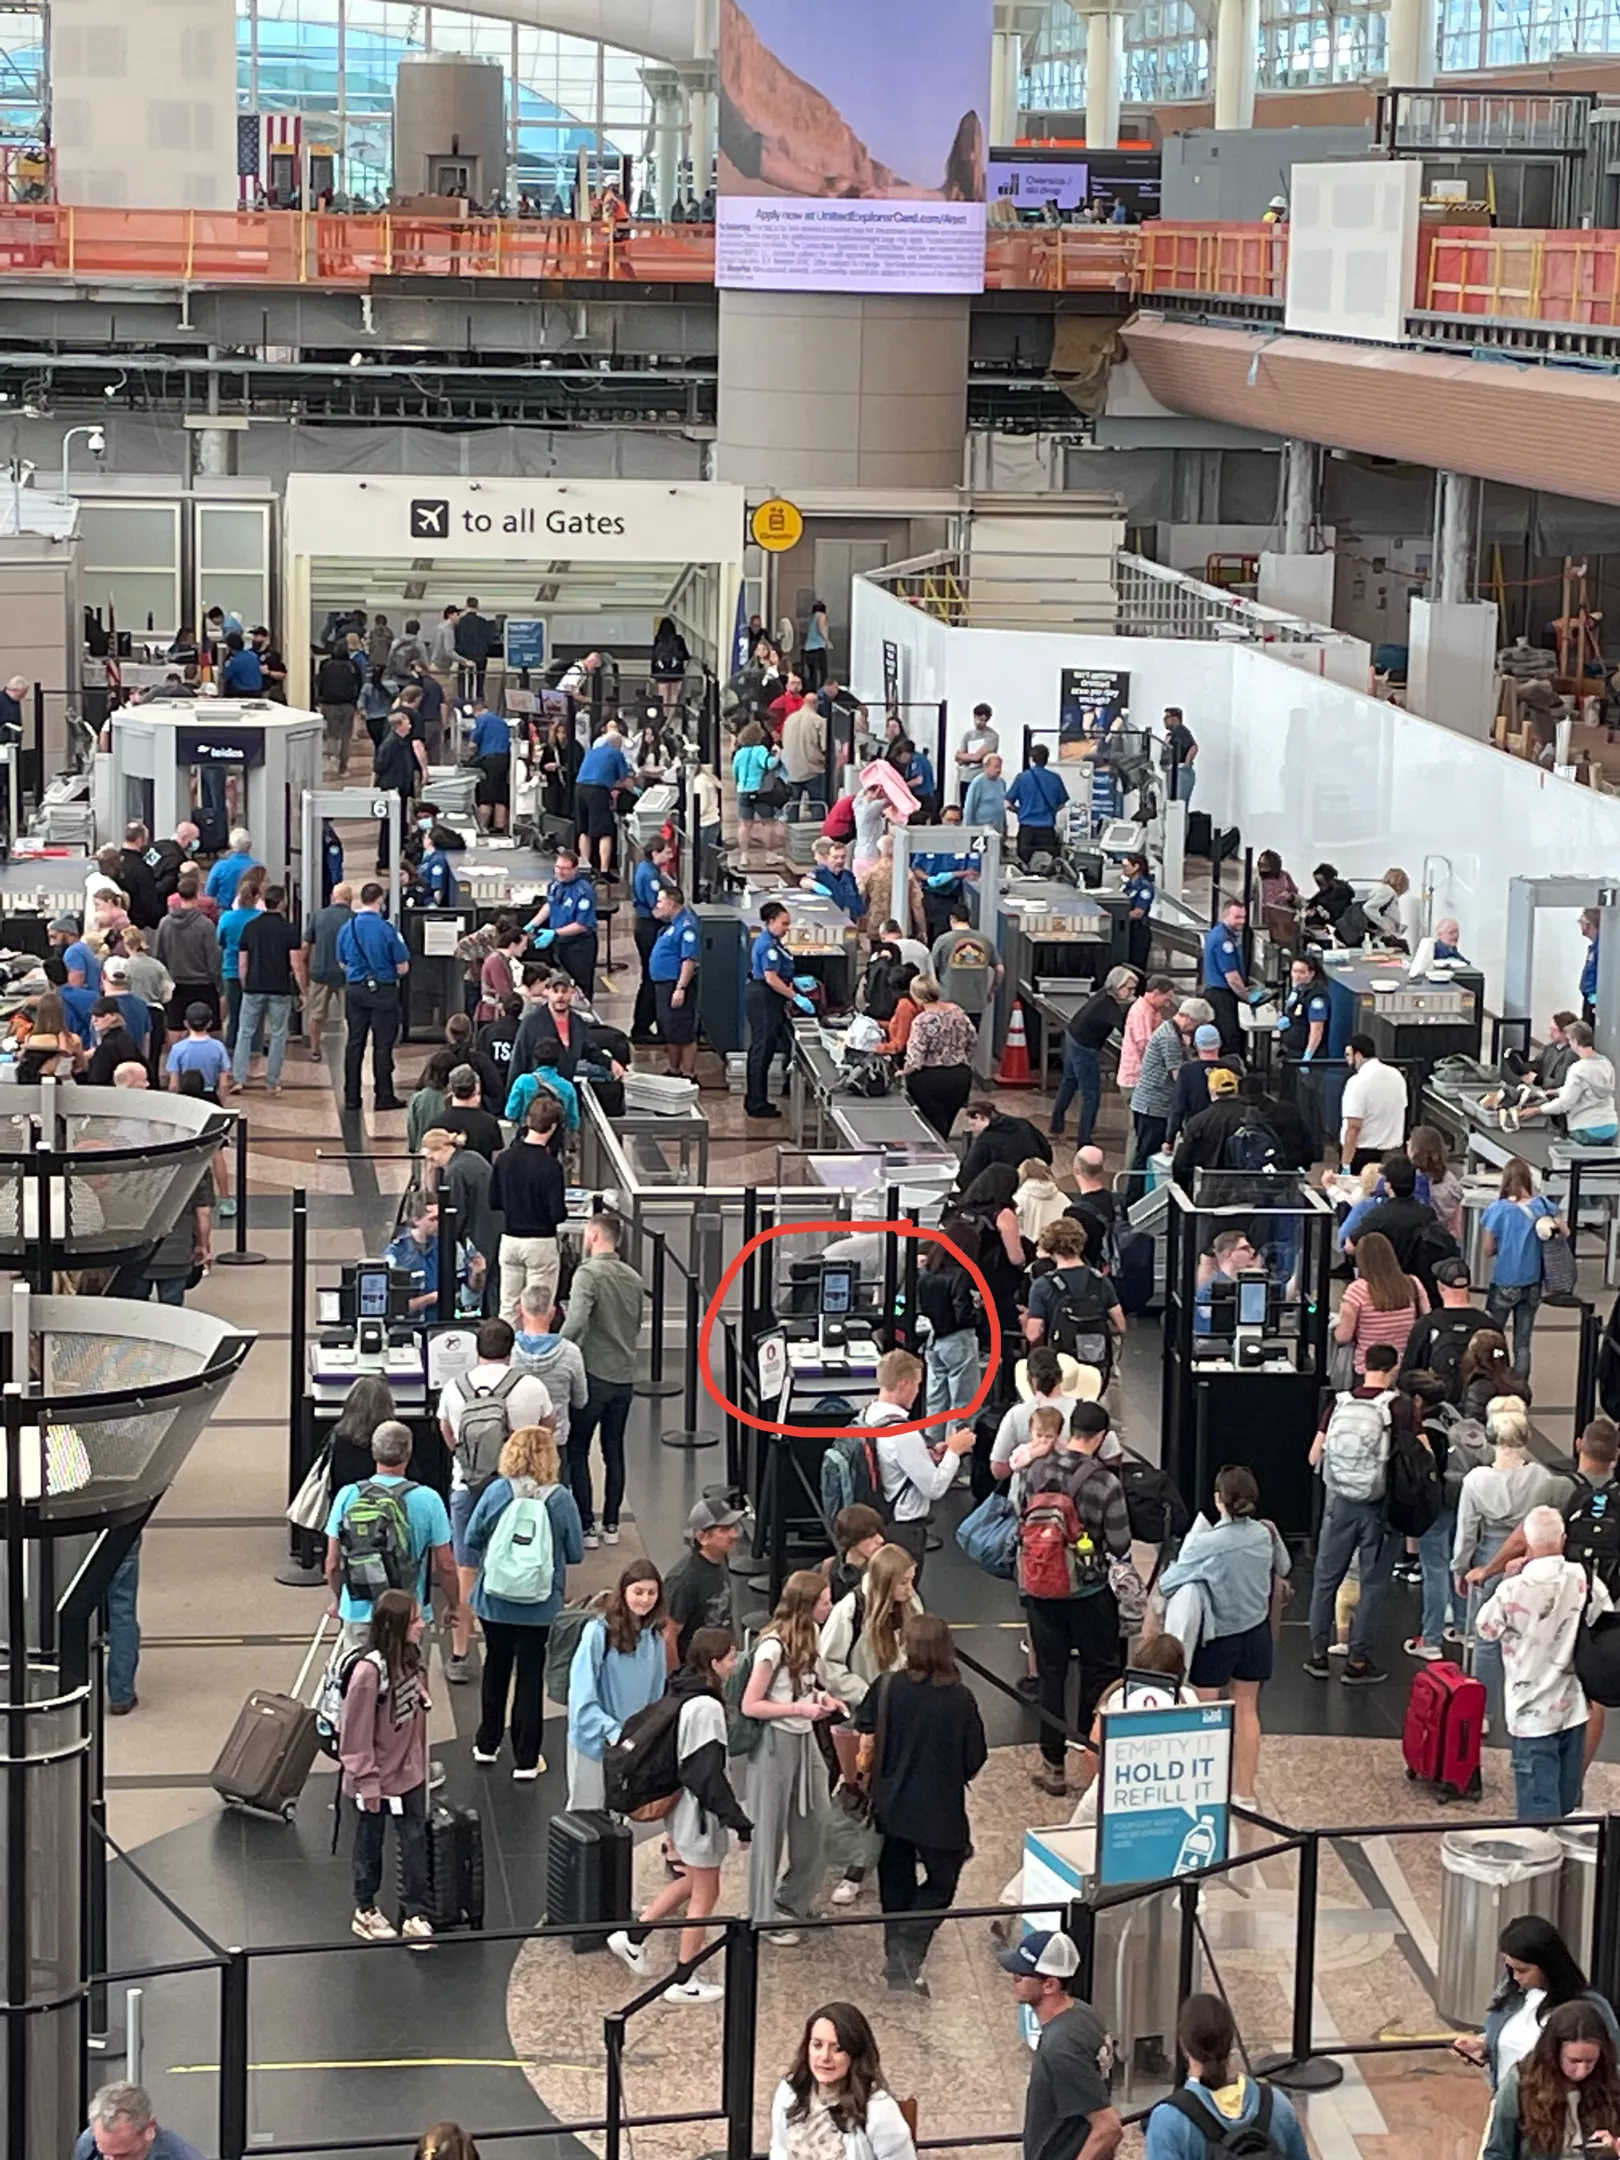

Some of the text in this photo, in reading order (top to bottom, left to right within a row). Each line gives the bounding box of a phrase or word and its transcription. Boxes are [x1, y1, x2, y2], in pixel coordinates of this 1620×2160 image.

[755, 208, 780, 222] Apply
[782, 211, 803, 220] now
[804, 211, 816, 221] at
[462, 508, 625, 535] to all Gates
[373, 800, 387, 818] 6
[972, 835, 986, 853] 4
[491, 1041, 512, 1061] TS
[1115, 1735, 1216, 1761] EMPTY IT
[1115, 1756, 1215, 1785] HOLD IT
[1114, 1780, 1215, 1808] REFILL IT
